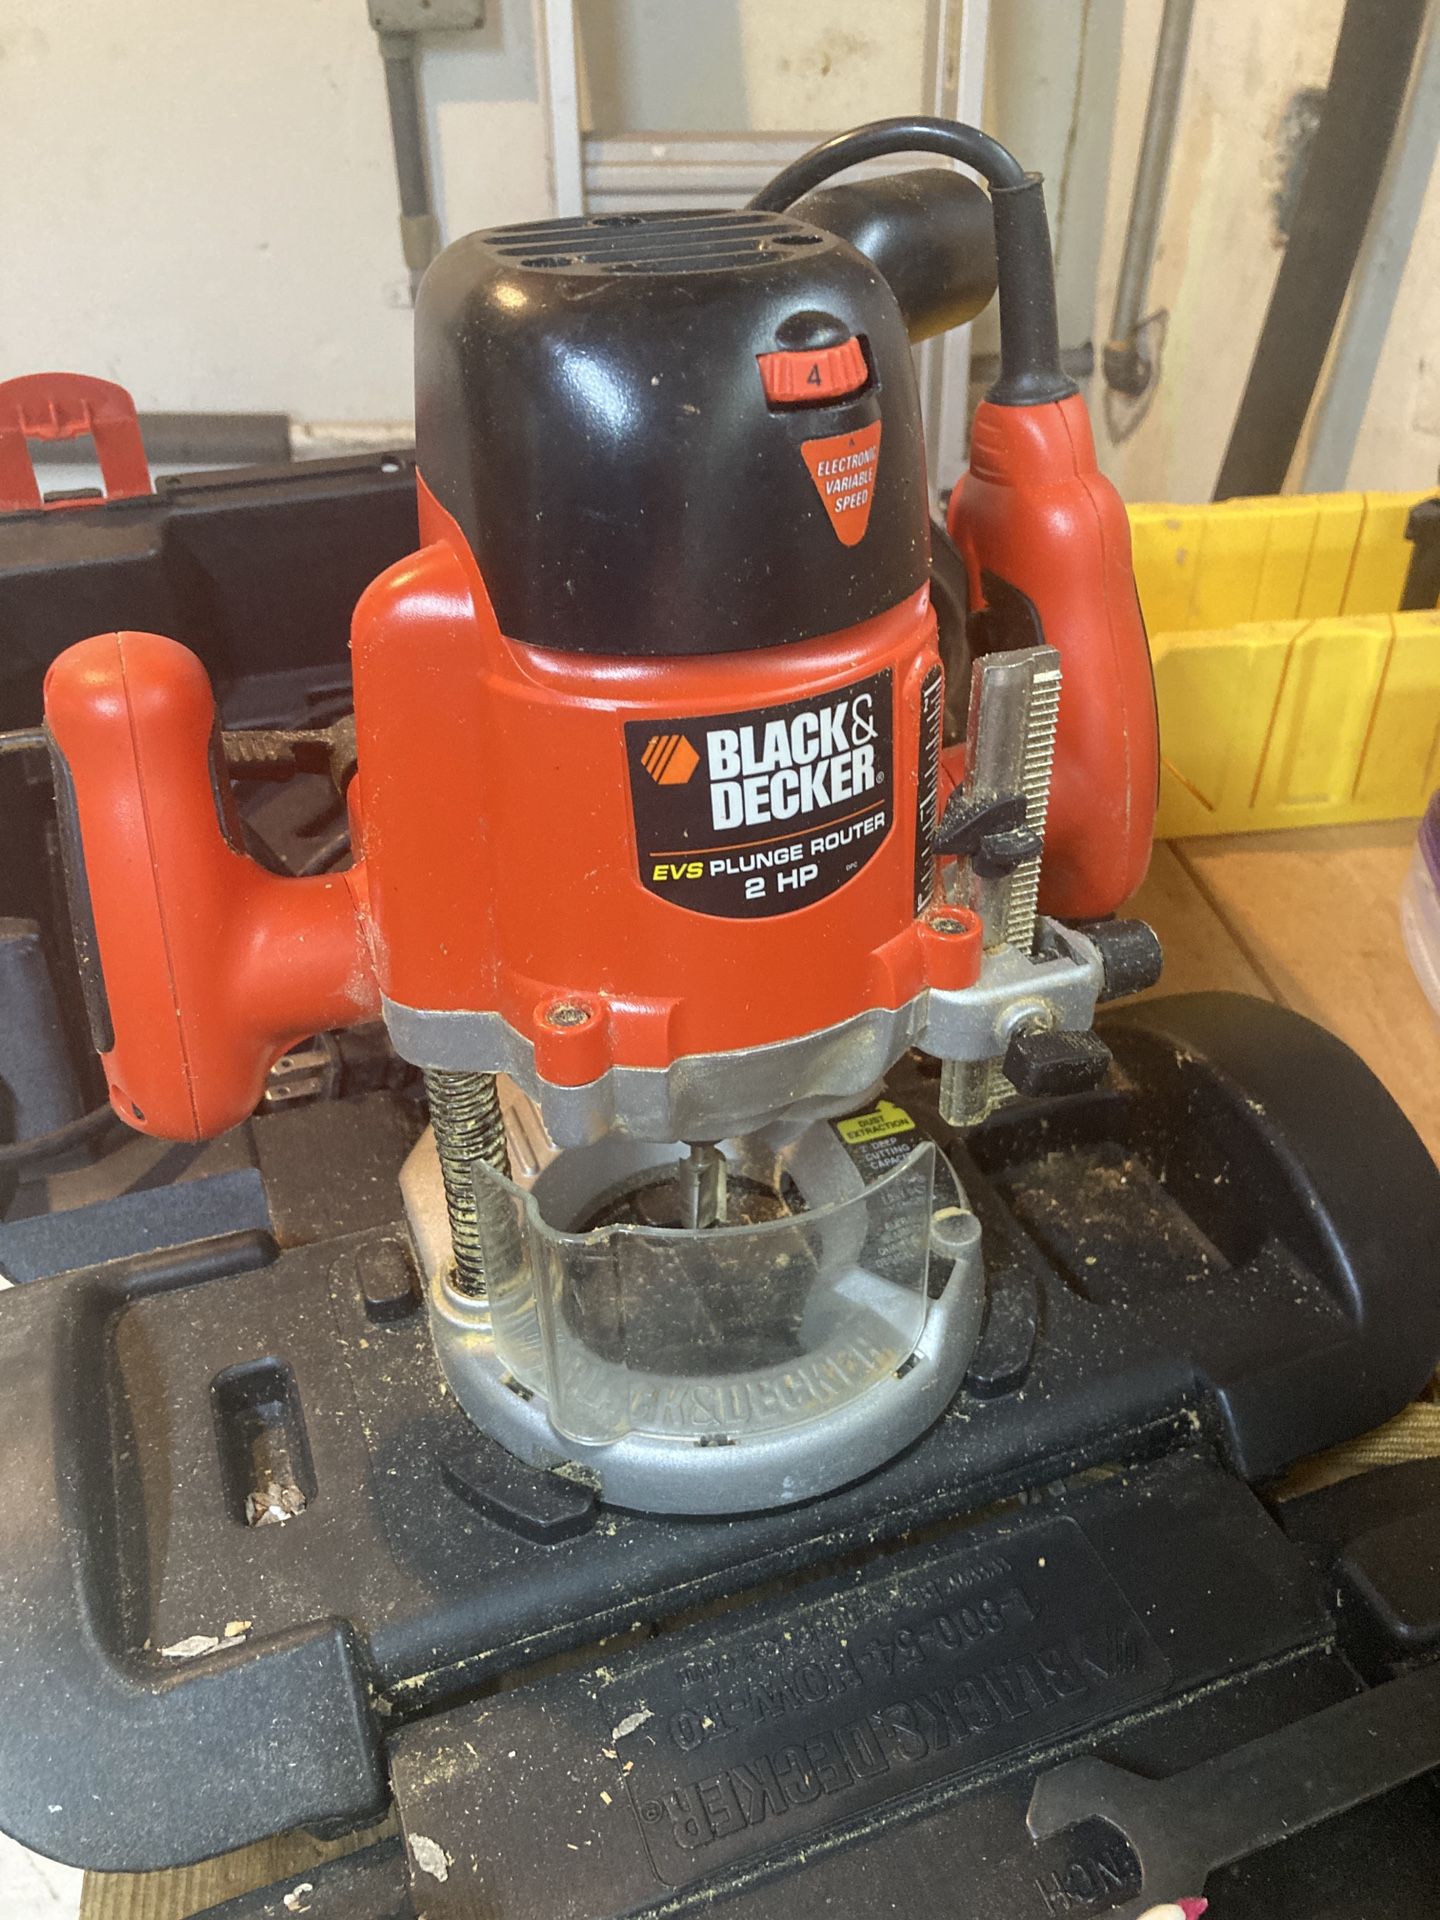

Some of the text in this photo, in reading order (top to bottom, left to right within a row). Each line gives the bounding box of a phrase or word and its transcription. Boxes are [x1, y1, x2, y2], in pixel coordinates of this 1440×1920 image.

[806, 364, 821, 387] 4
[826, 467, 873, 495] VARIABLE
[835, 489, 868, 513] SPEED
[652, 812, 886, 881] EVS PLUNGE ROUTER
[745, 864, 818, 900] 2 HP
[846, 1118, 910, 1140] EXTRACTION
[857, 1115, 884, 1128] DUST
[865, 1144, 911, 1162] CUTTING
[871, 1137, 897, 1150] DEEP
[1035, 1852, 1123, 1917] NCH
